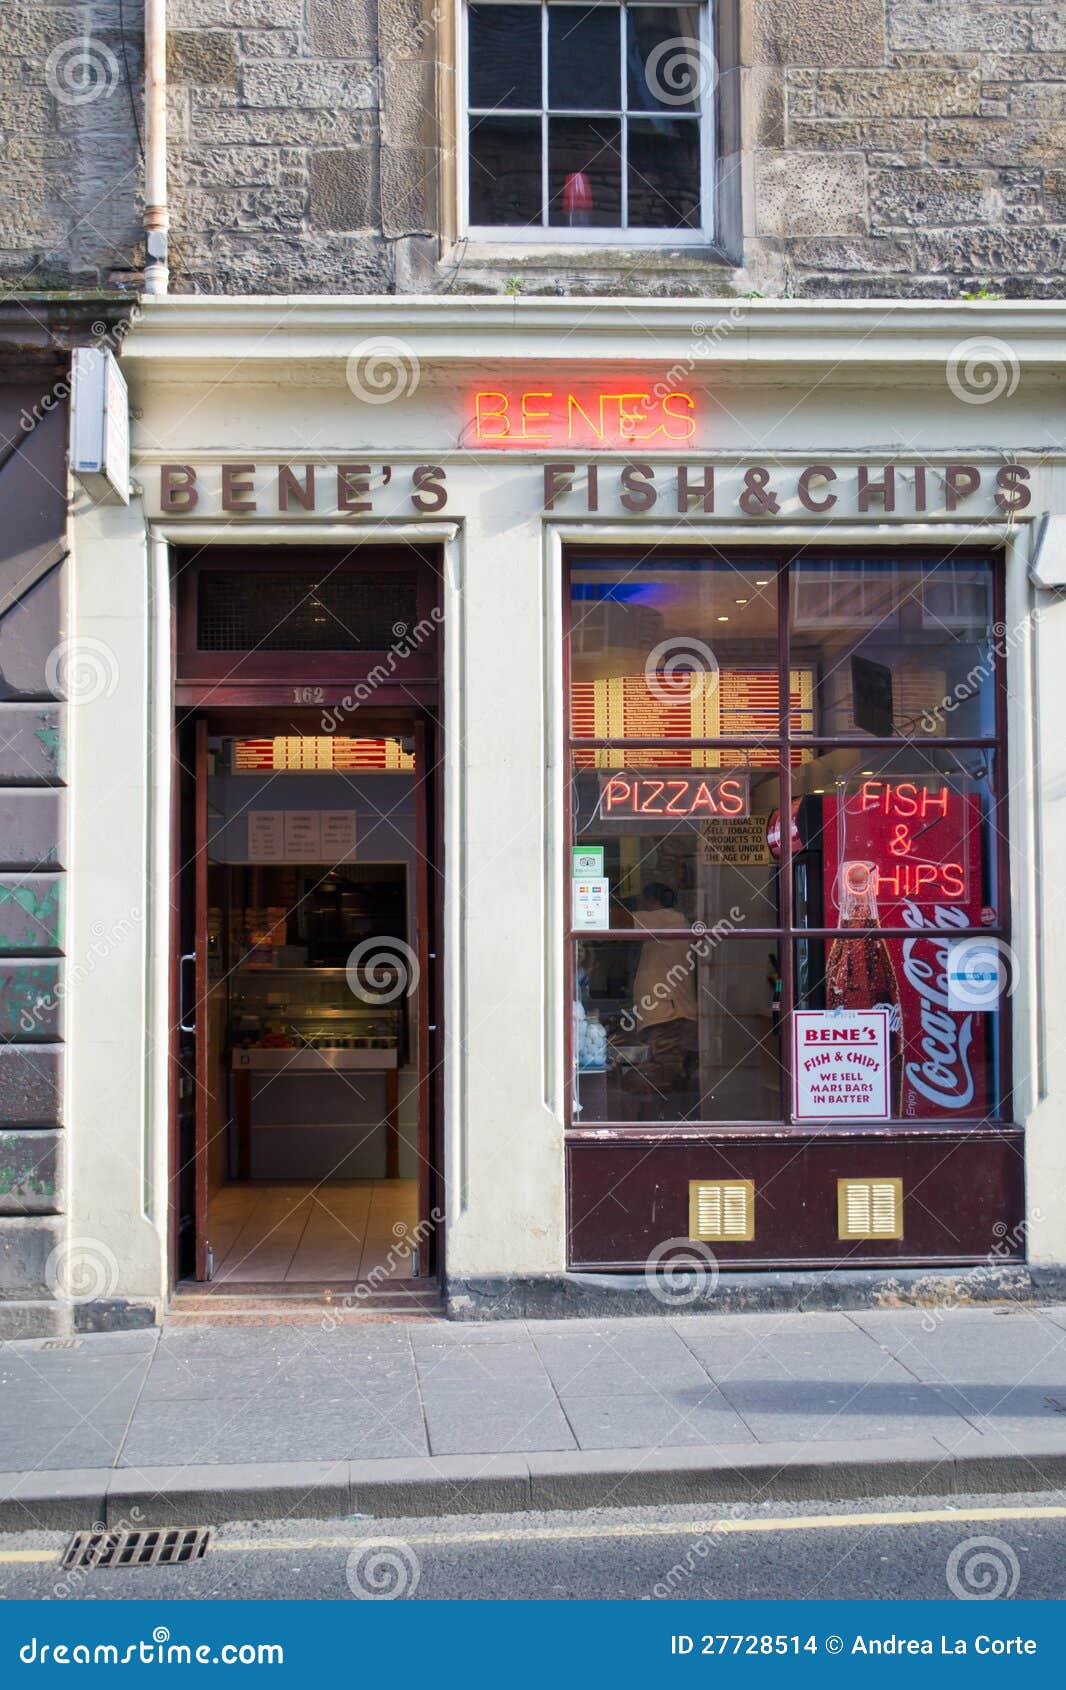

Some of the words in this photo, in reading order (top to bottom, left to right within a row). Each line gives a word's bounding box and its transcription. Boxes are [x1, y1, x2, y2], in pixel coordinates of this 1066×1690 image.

[160, 464, 447, 512] BENE'S
[293, 686, 324, 704] 162
[606, 780, 744, 815] PIZZAS
[861, 781, 949, 817] FISH
[755, 817, 766, 825] TO
[728, 826, 763, 834] TOBACCO
[706, 836, 749, 844] PRODUCTS
[752, 835, 762, 844] TO
[890, 823, 912, 857] &
[739, 845, 765, 853] UNDER
[705, 854, 719, 862] THE
[723, 854, 737, 862] AGE
[740, 854, 750, 862] OF
[844, 862, 965, 897] CHIPS
[805, 1027, 876, 1041] BENE'S
[803, 1052, 831, 1072] FISH
[834, 1051, 843, 1062] &
[846, 1052, 880, 1072] CHIPS
[820, 1073, 837, 1081] WE
[841, 1072, 863, 1081] SELL
[810, 1084, 842, 1093] MARS
[845, 1084, 873, 1092] BARS
[813, 1095, 825, 1104] IN
[828, 1095, 870, 1103] BATTER
[905, 1089, 917, 1116] Enjoy
